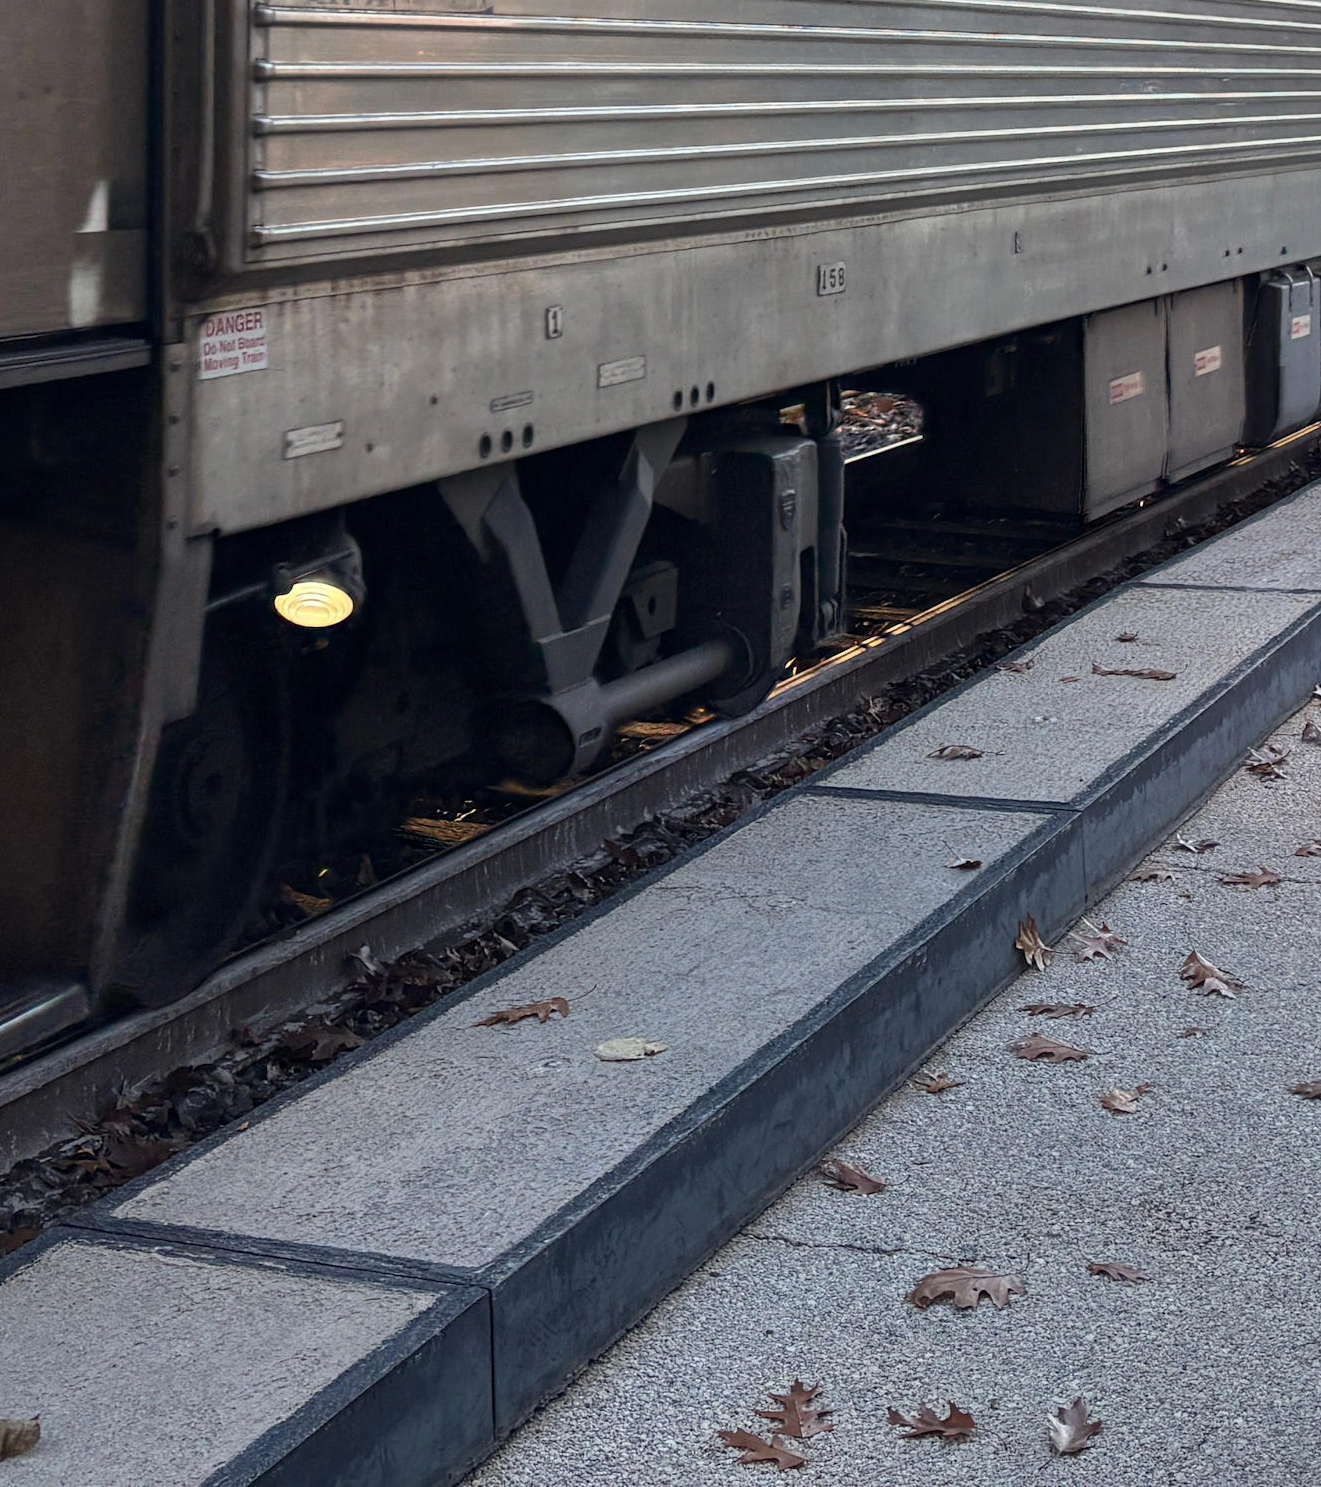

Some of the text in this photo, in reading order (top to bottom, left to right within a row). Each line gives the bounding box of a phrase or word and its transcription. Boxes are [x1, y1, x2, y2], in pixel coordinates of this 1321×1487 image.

[822, 267, 845, 290] 158
[206, 312, 262, 337] DANGER
[203, 342, 217, 356] Do
[220, 339, 235, 354] Not
[204, 351, 264, 372] Moving Train
